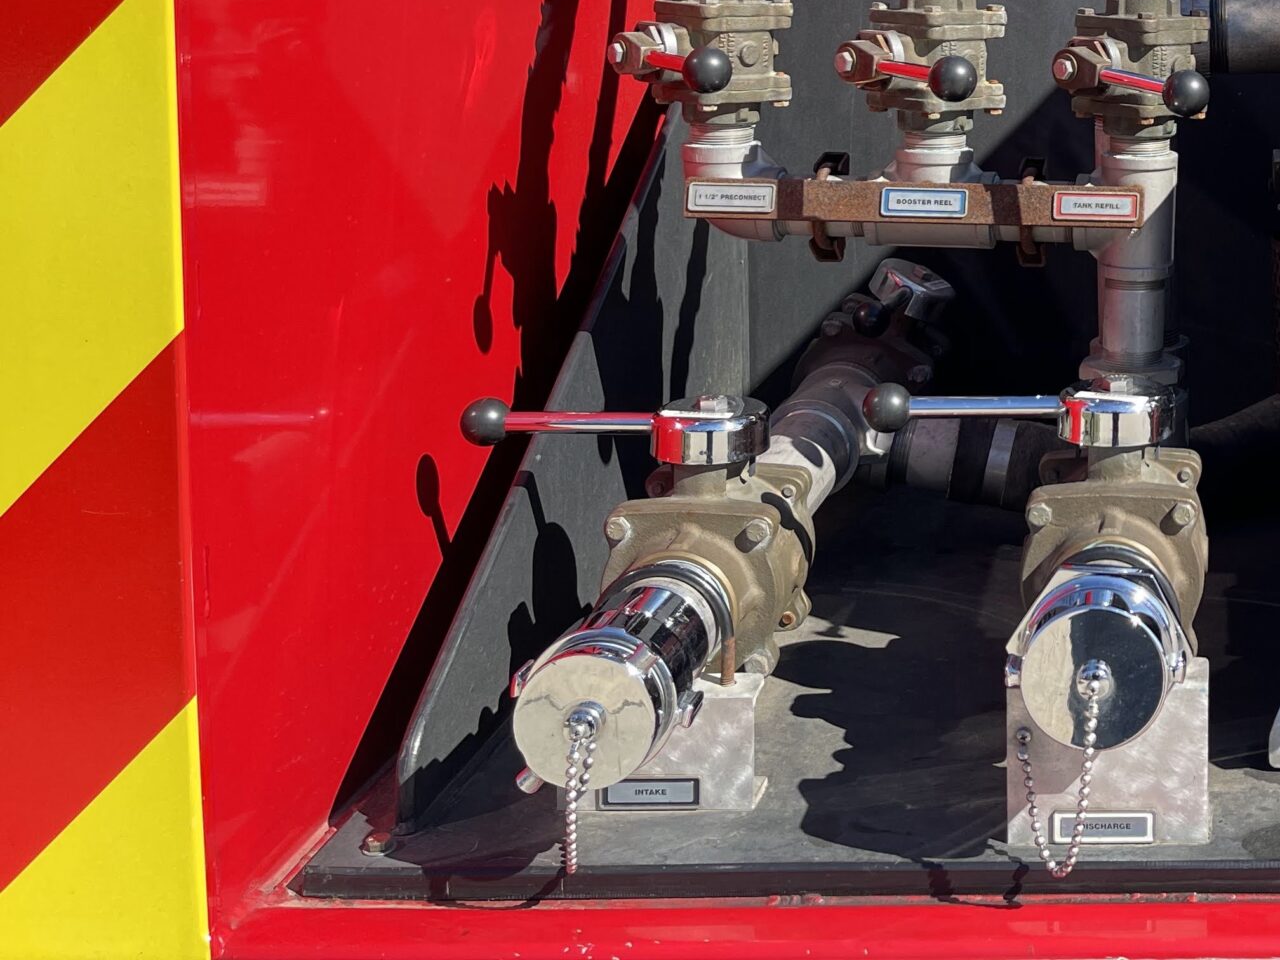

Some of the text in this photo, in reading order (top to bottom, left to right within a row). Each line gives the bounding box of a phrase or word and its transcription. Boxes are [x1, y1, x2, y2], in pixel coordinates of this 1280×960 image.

[896, 198, 953, 207] BOOSTER REEL
[1072, 201, 1121, 210] TANK REFILL
[634, 788, 667, 796] INTAKE
